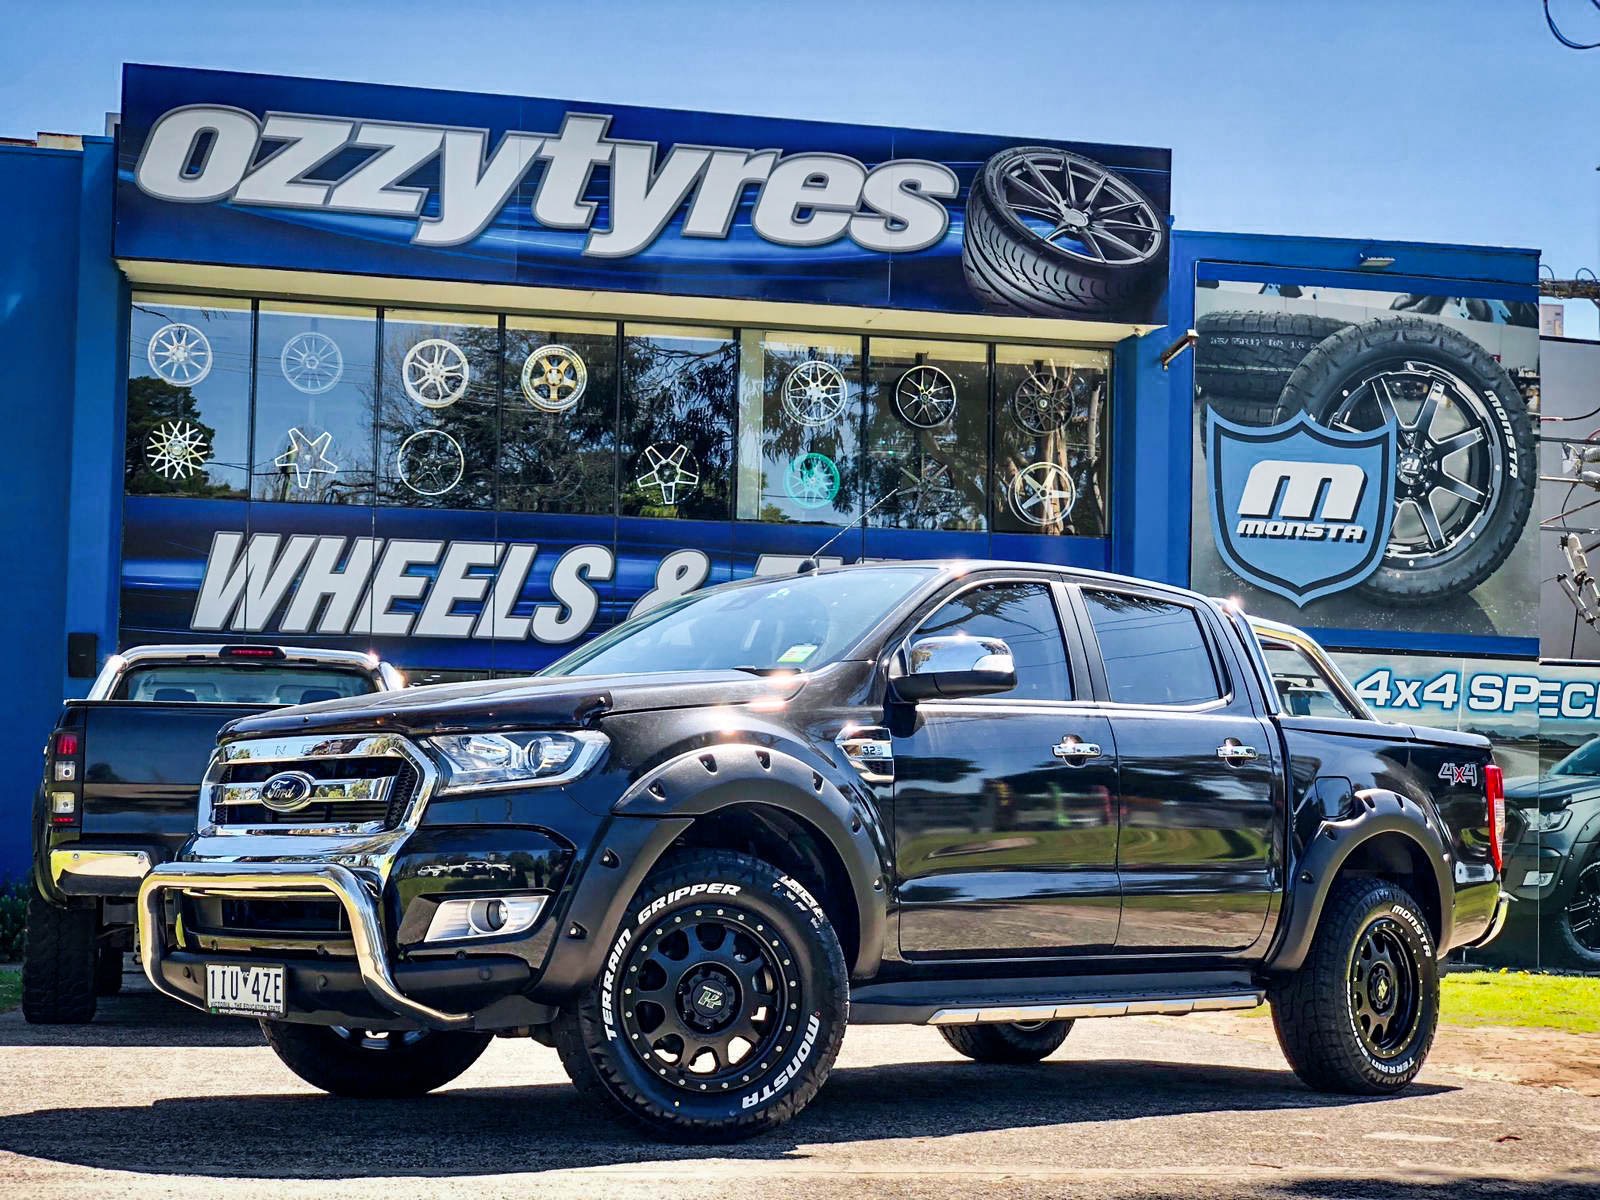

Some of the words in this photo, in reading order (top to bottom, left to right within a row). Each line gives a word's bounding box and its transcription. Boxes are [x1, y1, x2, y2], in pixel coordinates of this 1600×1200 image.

[134, 103, 960, 259] ozzytyres
[1484, 389, 1518, 480] MONSTA
[1236, 520, 1366, 543] MONSTA
[189, 531, 615, 644] WHEELS
[1355, 669, 1459, 710] 4x4
[266, 779, 295, 799] Ford
[1438, 762, 1478, 787] 4x4
[1391, 904, 1432, 958] MONSTA
[600, 928, 632, 1042] TERRAIN
[637, 882, 741, 925] GRIPPER
[741, 1014, 821, 1110] MONSTA
[1371, 1057, 1415, 1073] TERRAIN
